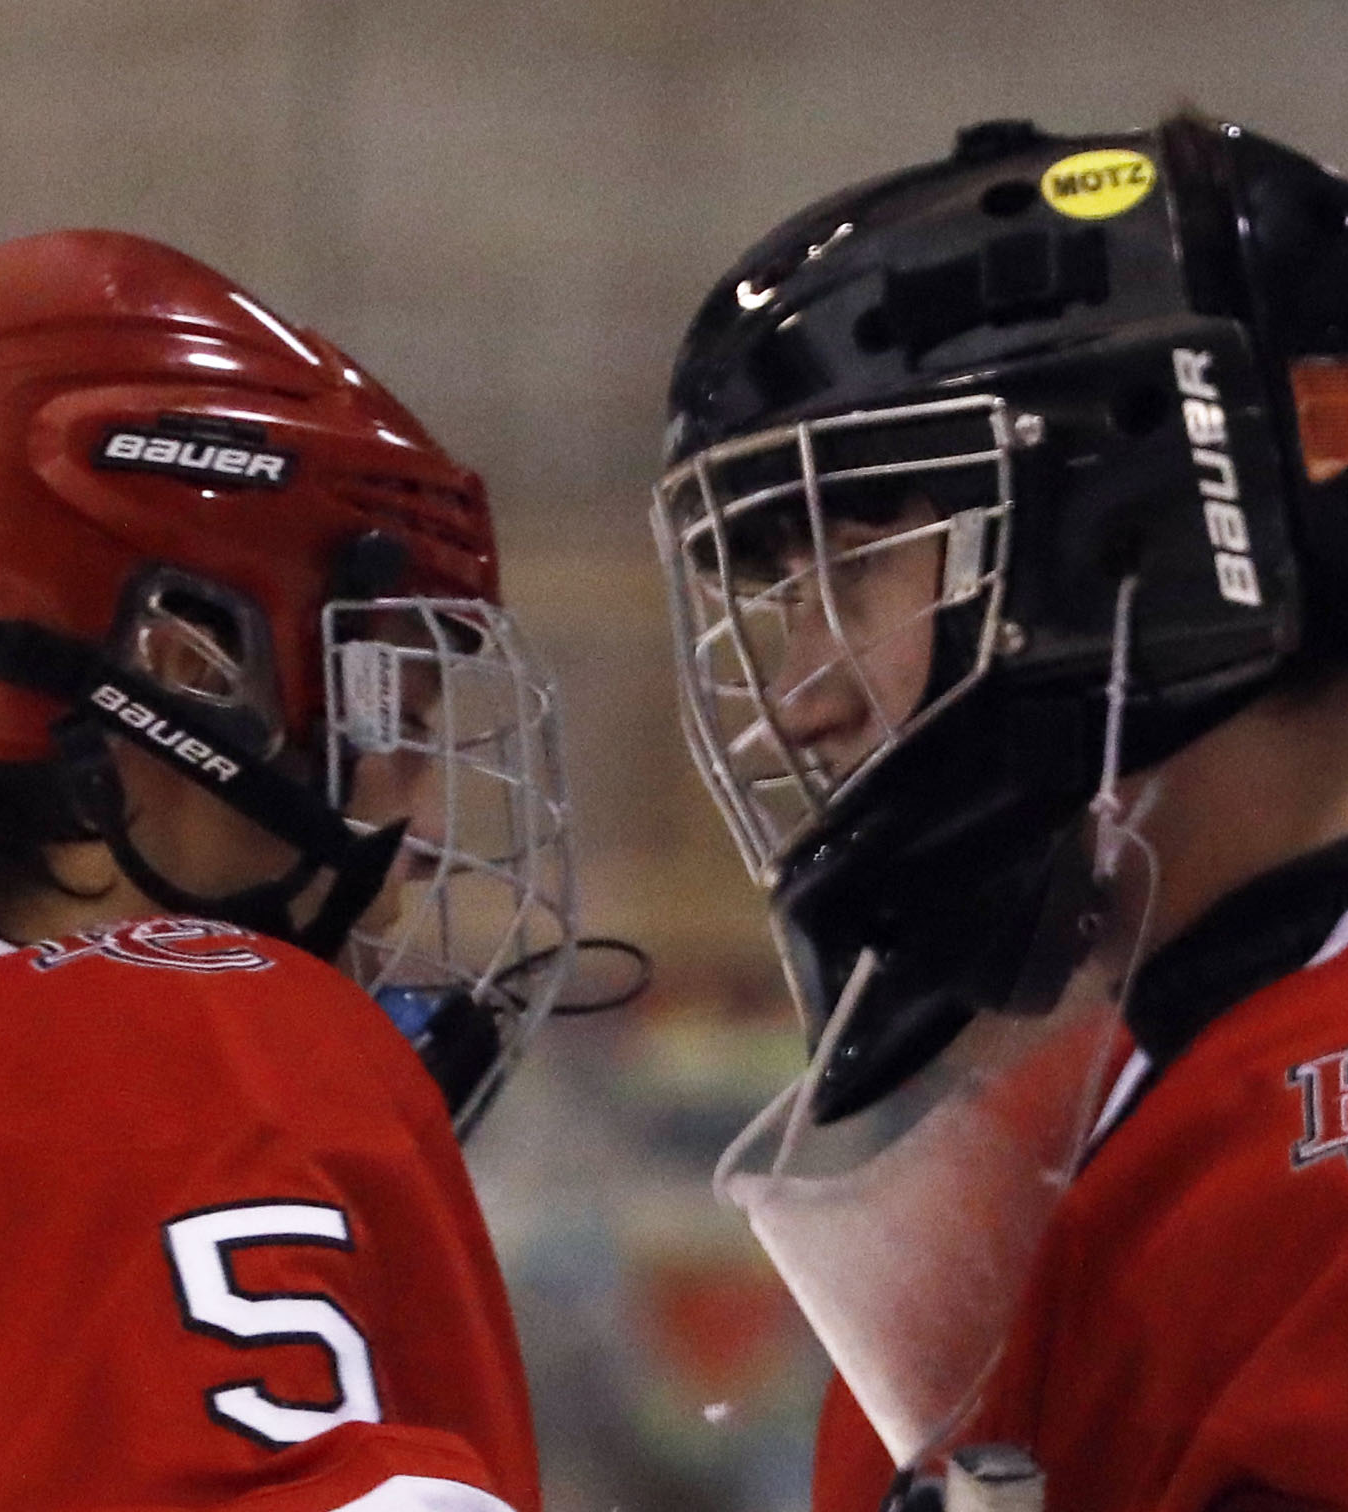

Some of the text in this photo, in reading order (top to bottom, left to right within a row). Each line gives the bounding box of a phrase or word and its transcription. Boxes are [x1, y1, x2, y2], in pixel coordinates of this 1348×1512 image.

[1052, 161, 1149, 198] MOTZ
[105, 432, 287, 483] BAUER
[1172, 348, 1262, 607] BAUER
[91, 684, 240, 782] BAUER
[161, 1197, 383, 1452] 5
